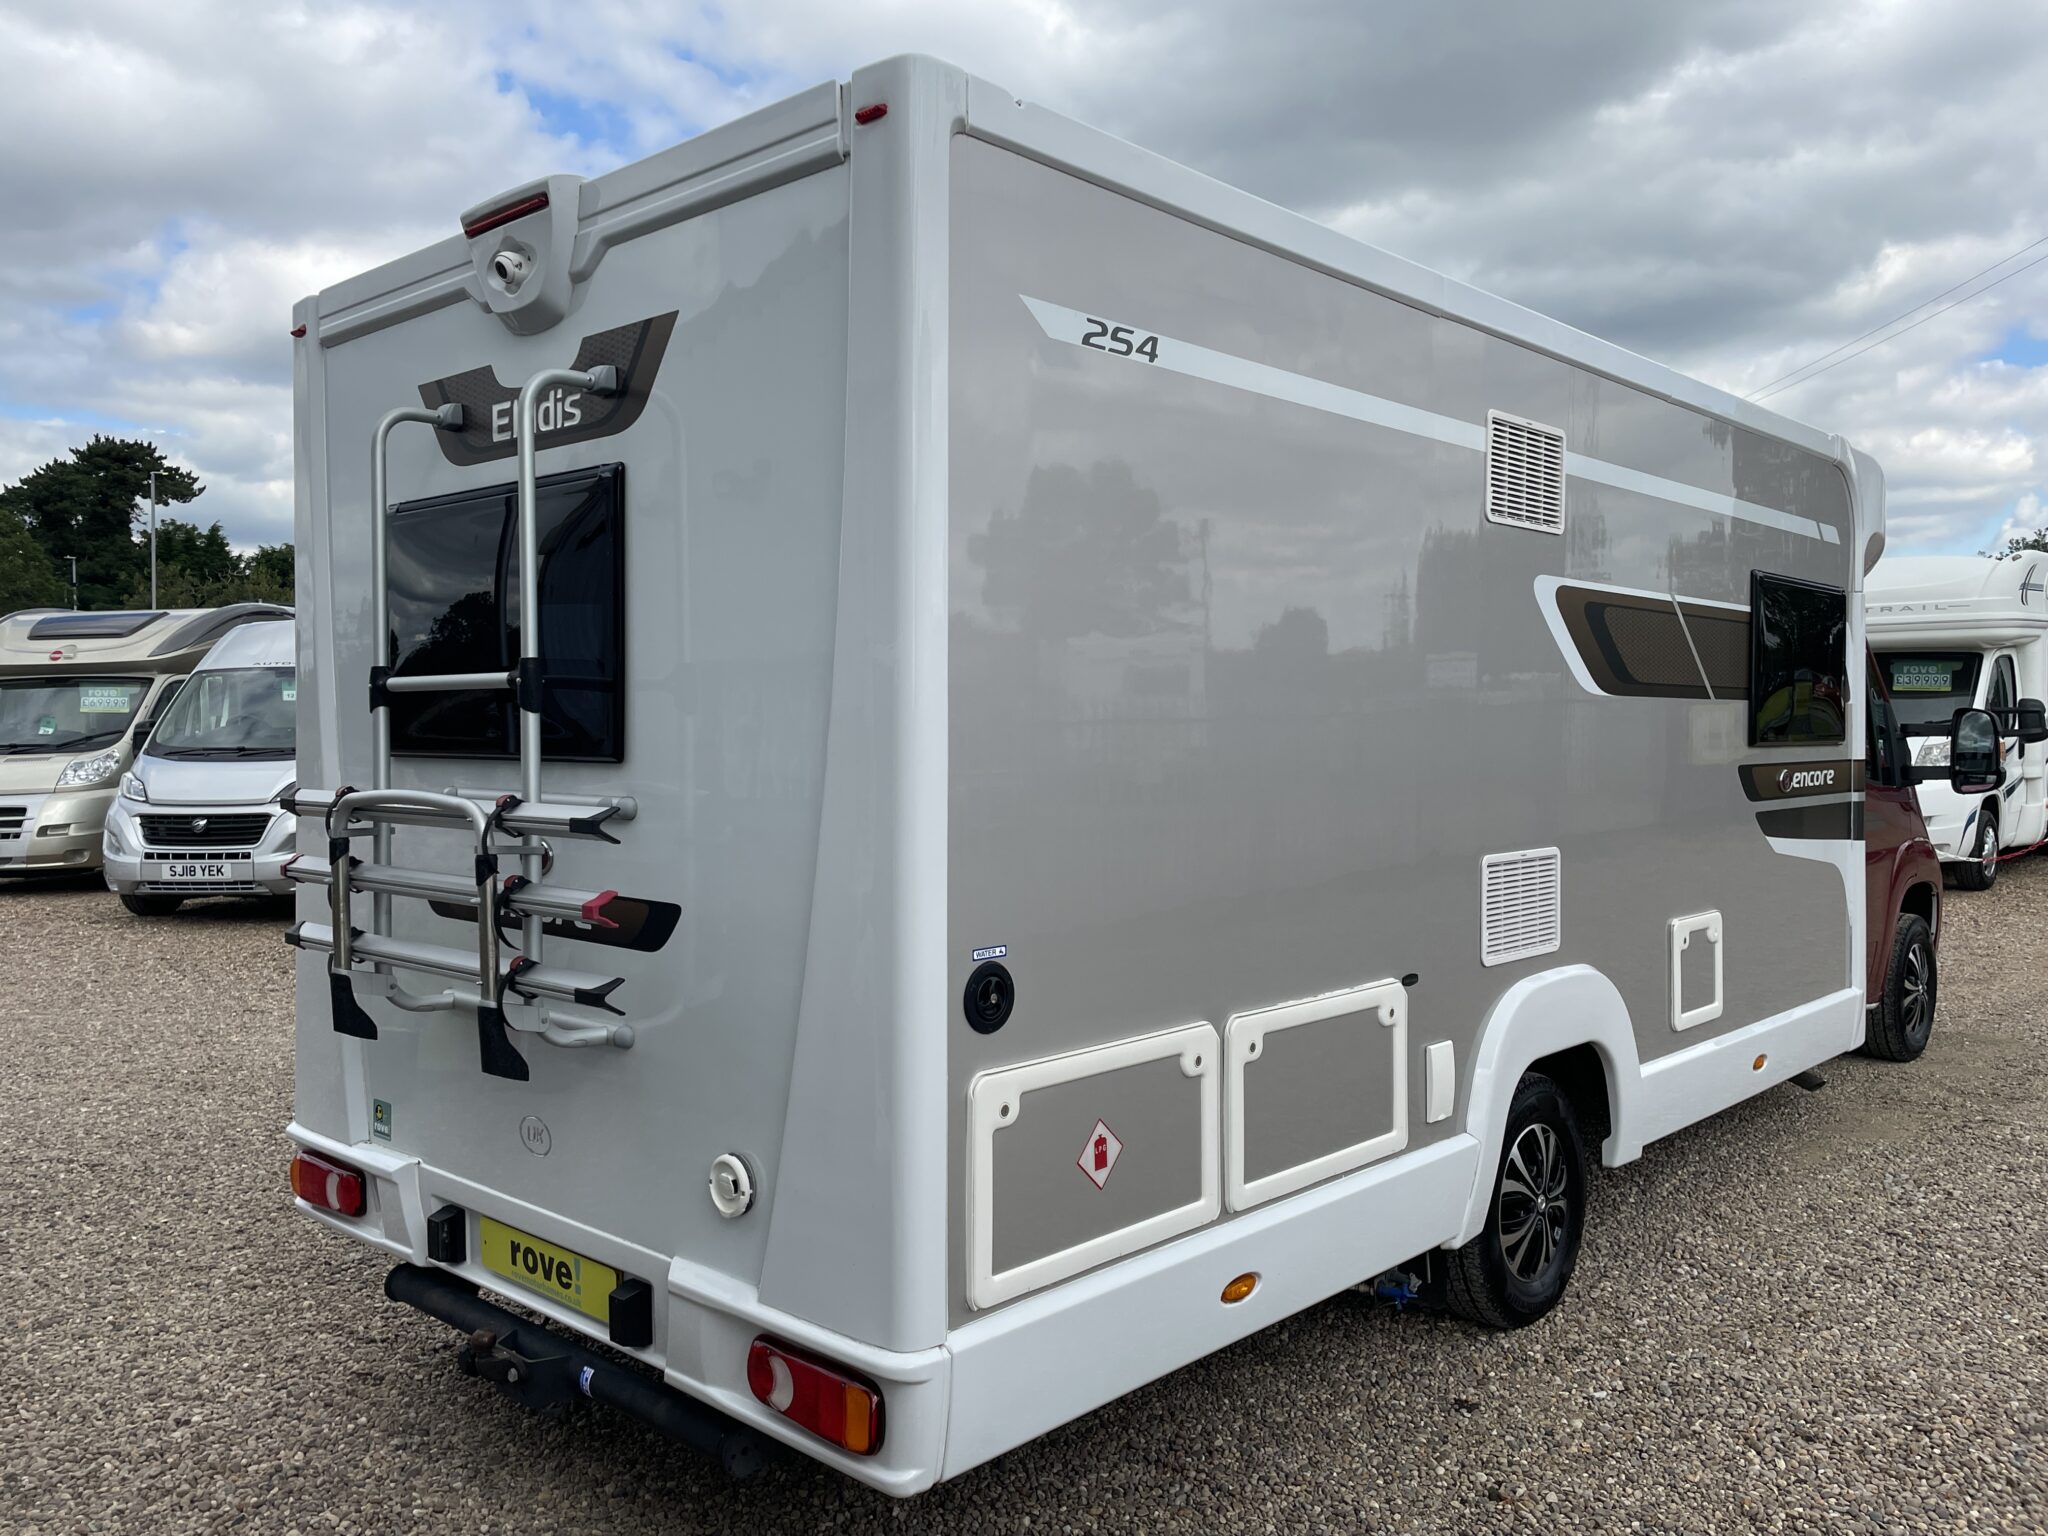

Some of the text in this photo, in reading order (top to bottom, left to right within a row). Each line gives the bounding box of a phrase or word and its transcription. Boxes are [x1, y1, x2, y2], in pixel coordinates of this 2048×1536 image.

[1081, 317, 1159, 363] 254
[492, 387, 582, 443] Eldis
[1895, 675, 1949, 686] £39999
[82, 697, 127, 708] £69999
[1793, 768, 1835, 788] encore
[169, 865, 225, 877] SJ18 YEK
[975, 948, 997, 958] WATER
[527, 1125, 544, 1144] UK
[1095, 1144, 1107, 1154] LPG
[510, 1239, 581, 1296] rove!
